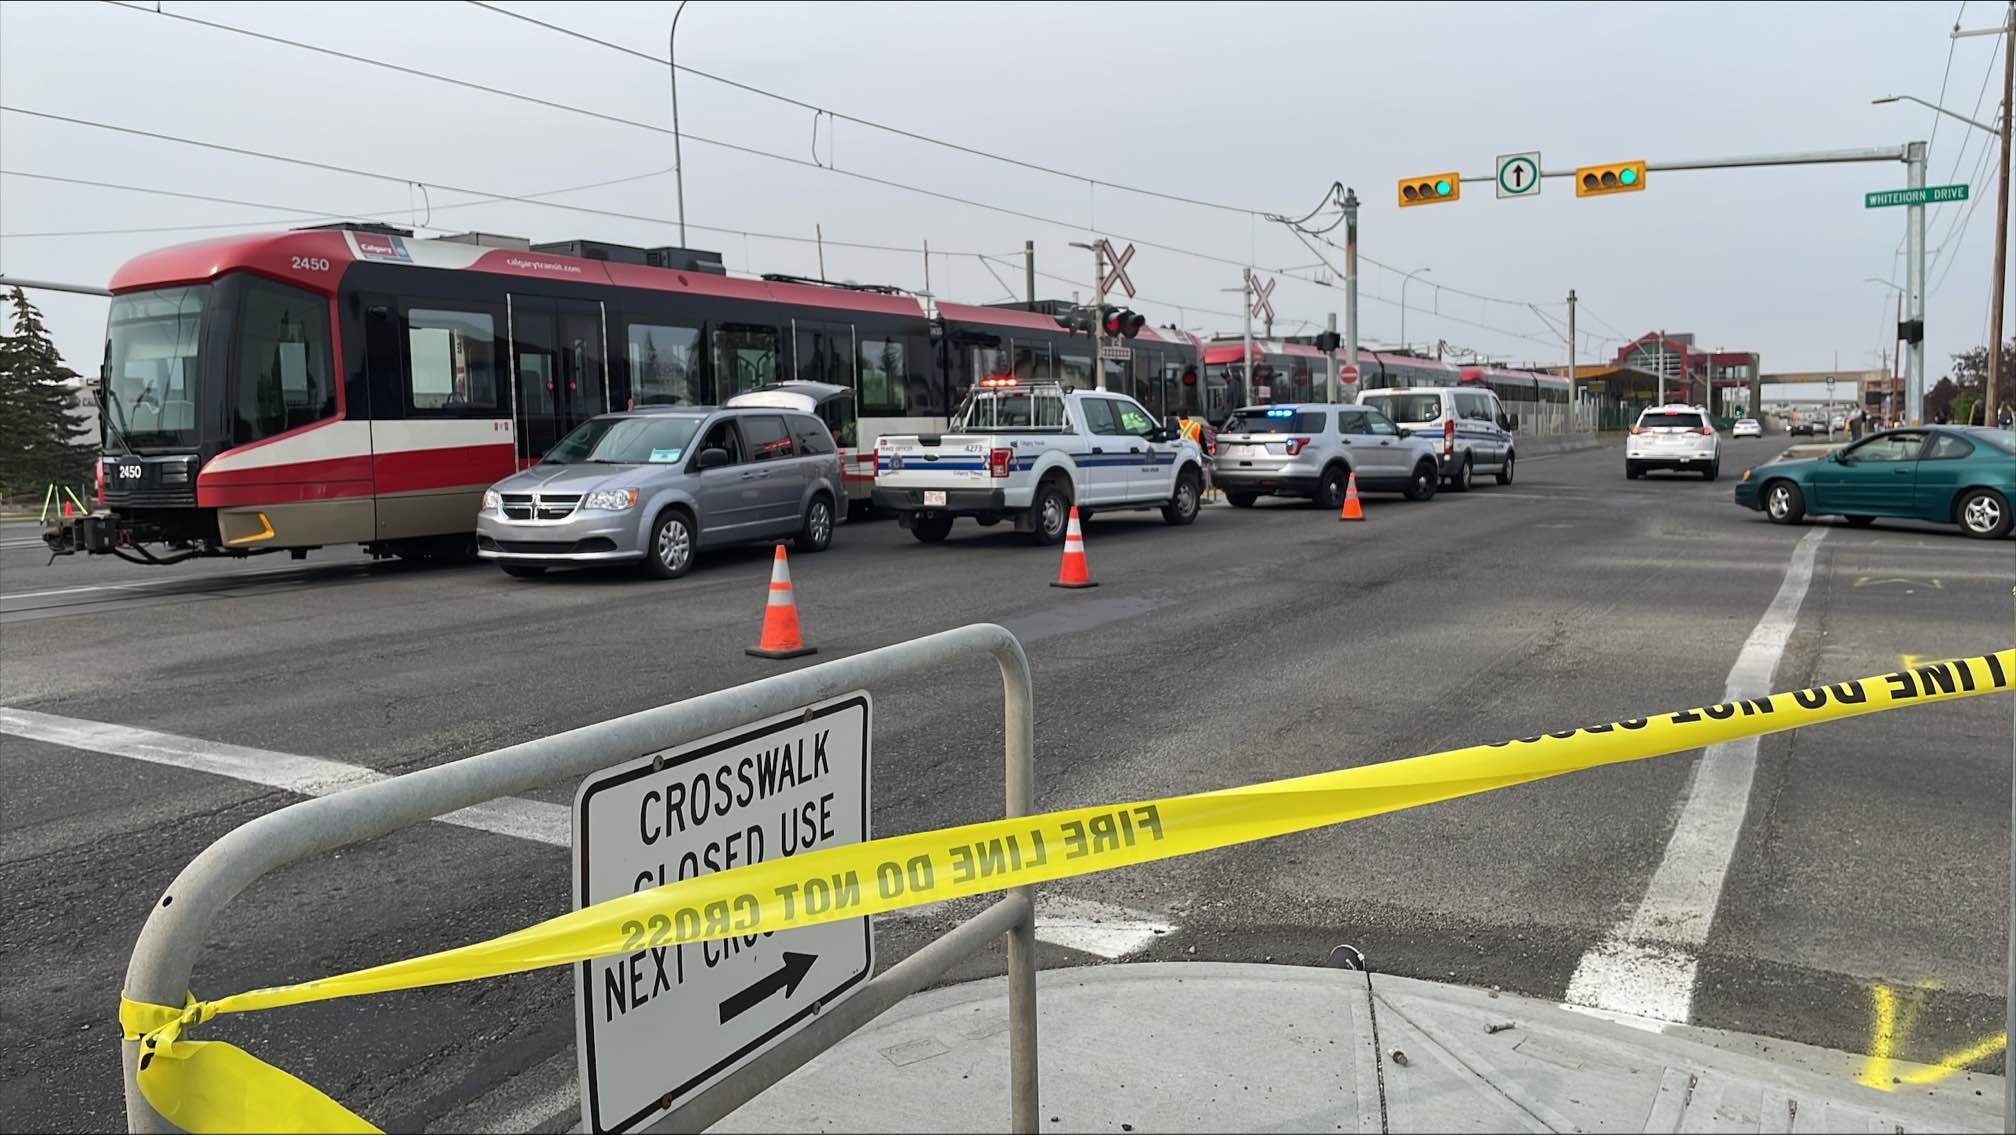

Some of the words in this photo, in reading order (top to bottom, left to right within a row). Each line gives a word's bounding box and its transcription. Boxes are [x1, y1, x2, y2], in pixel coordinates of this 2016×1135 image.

[1870, 189, 1926, 205] WHITEHORN
[1934, 187, 1964, 200] DRIVE
[361, 243, 392, 254] Calgary
[291, 256, 329, 271] 2450
[507, 258, 581, 272] calgarytransit.com
[964, 444, 982, 452] 4273
[119, 465, 141, 478] 2450
[640, 729, 829, 845] CROSSWALK
[781, 792, 835, 857] USE
[605, 944, 684, 1022] NEXT
